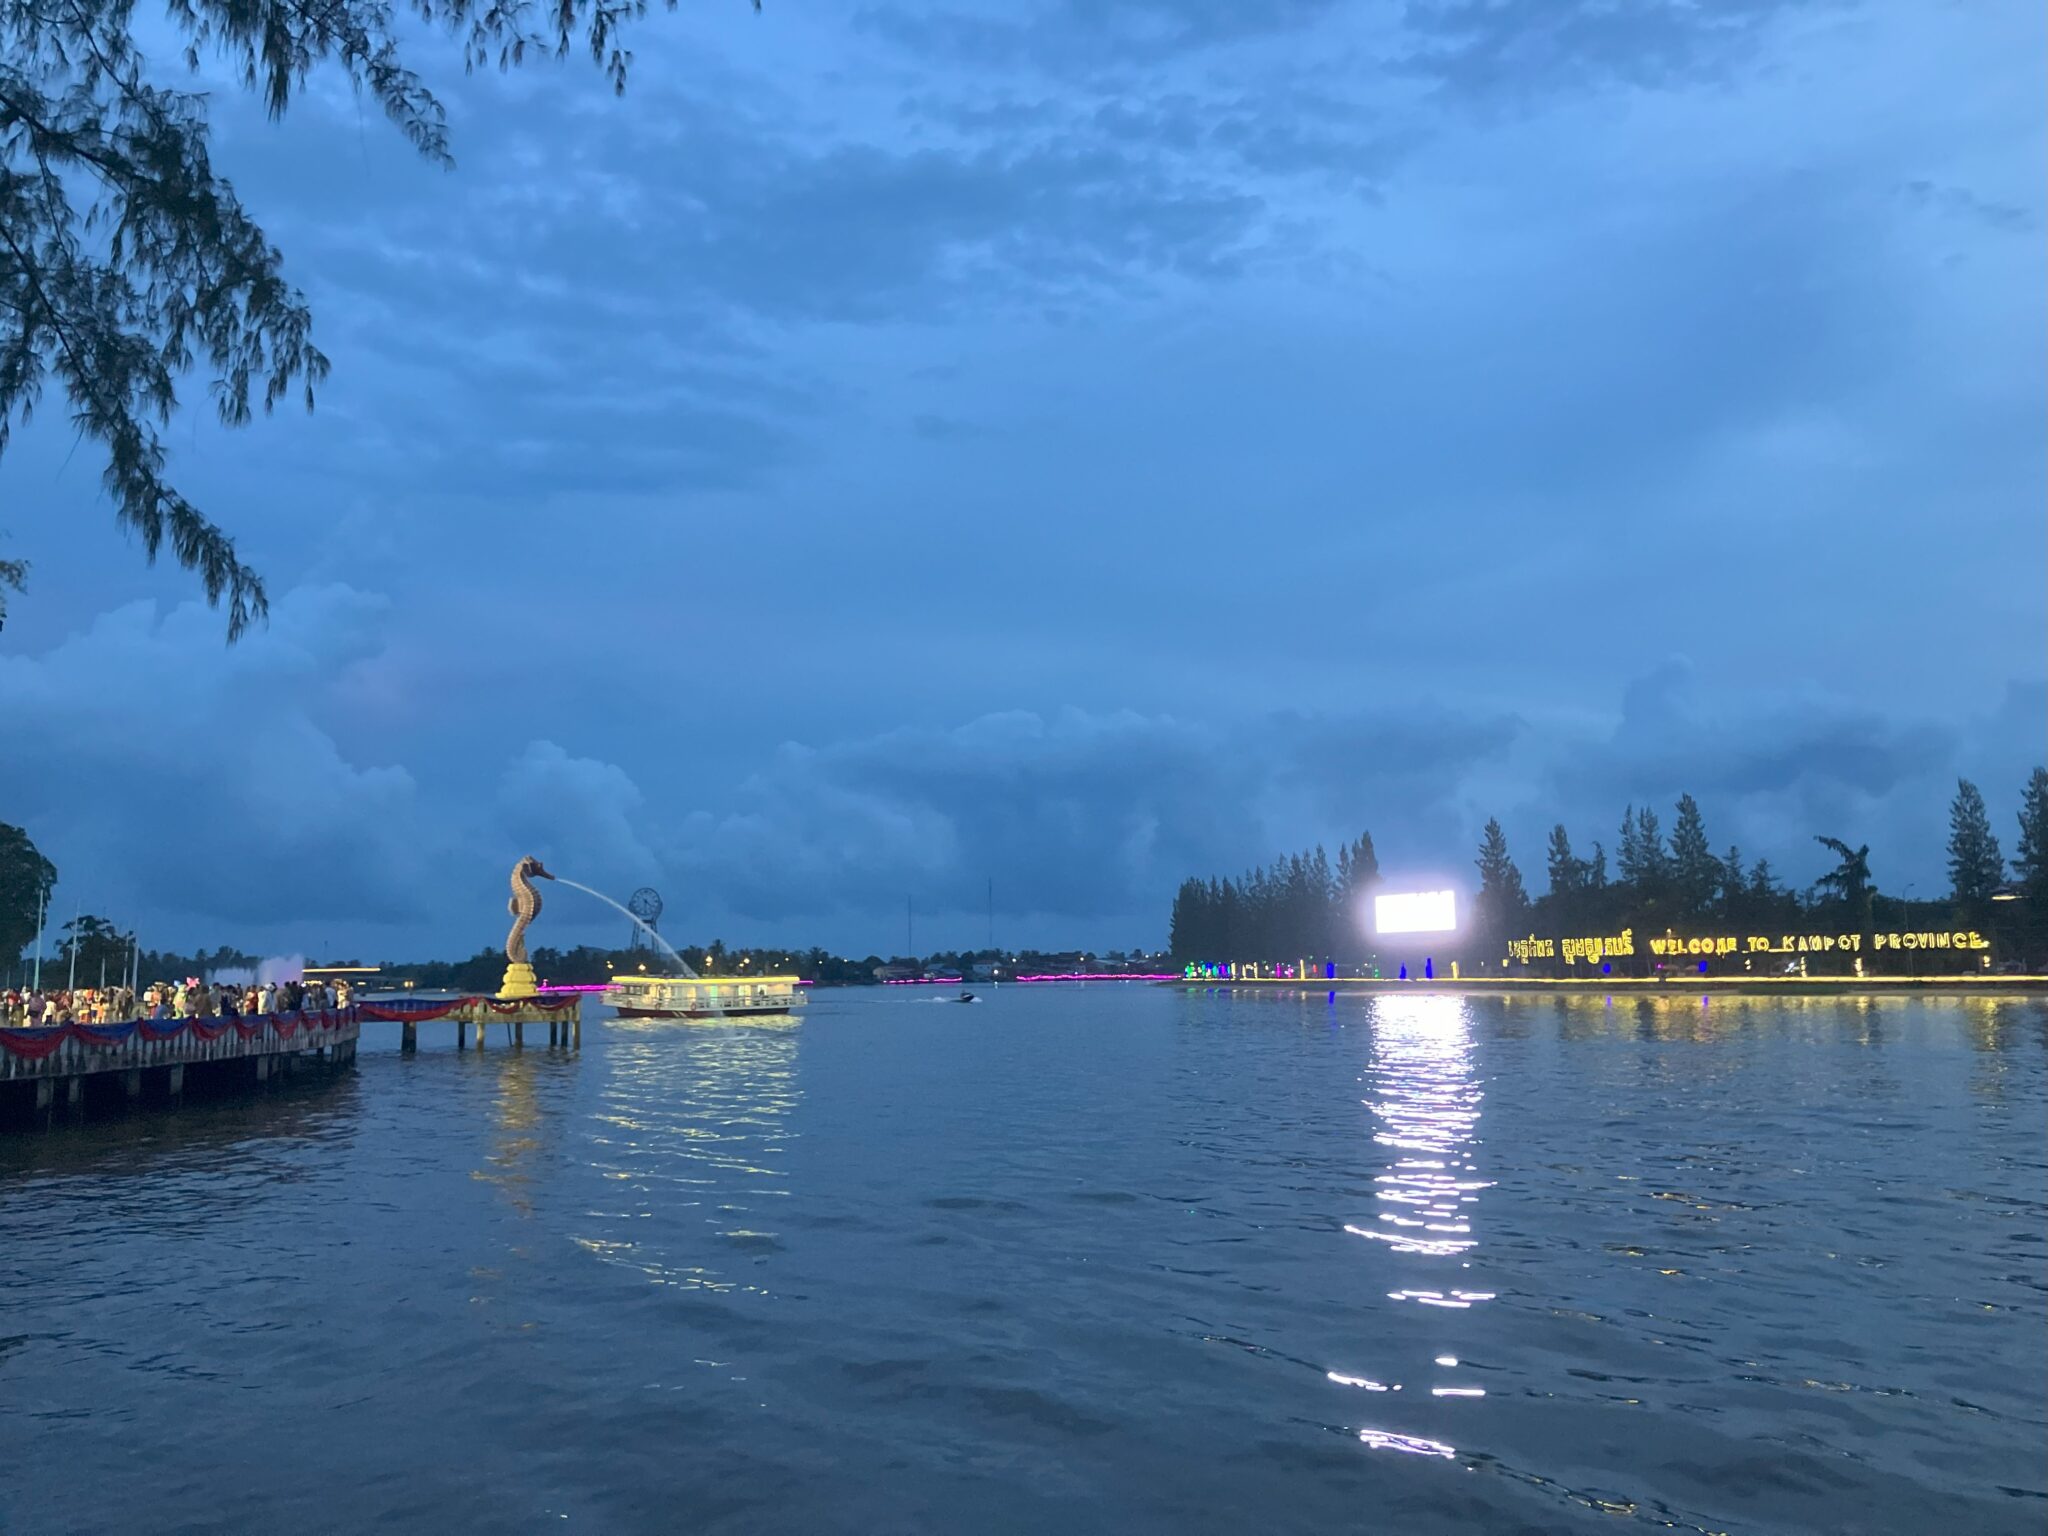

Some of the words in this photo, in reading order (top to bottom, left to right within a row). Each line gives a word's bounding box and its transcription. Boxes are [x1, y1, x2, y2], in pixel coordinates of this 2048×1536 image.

[1650, 936, 1737, 955] WELCOME
[1748, 936, 1769, 950] TO
[1783, 935, 1861, 951] KAMPOT
[1874, 932, 1985, 950] PROVINCE
